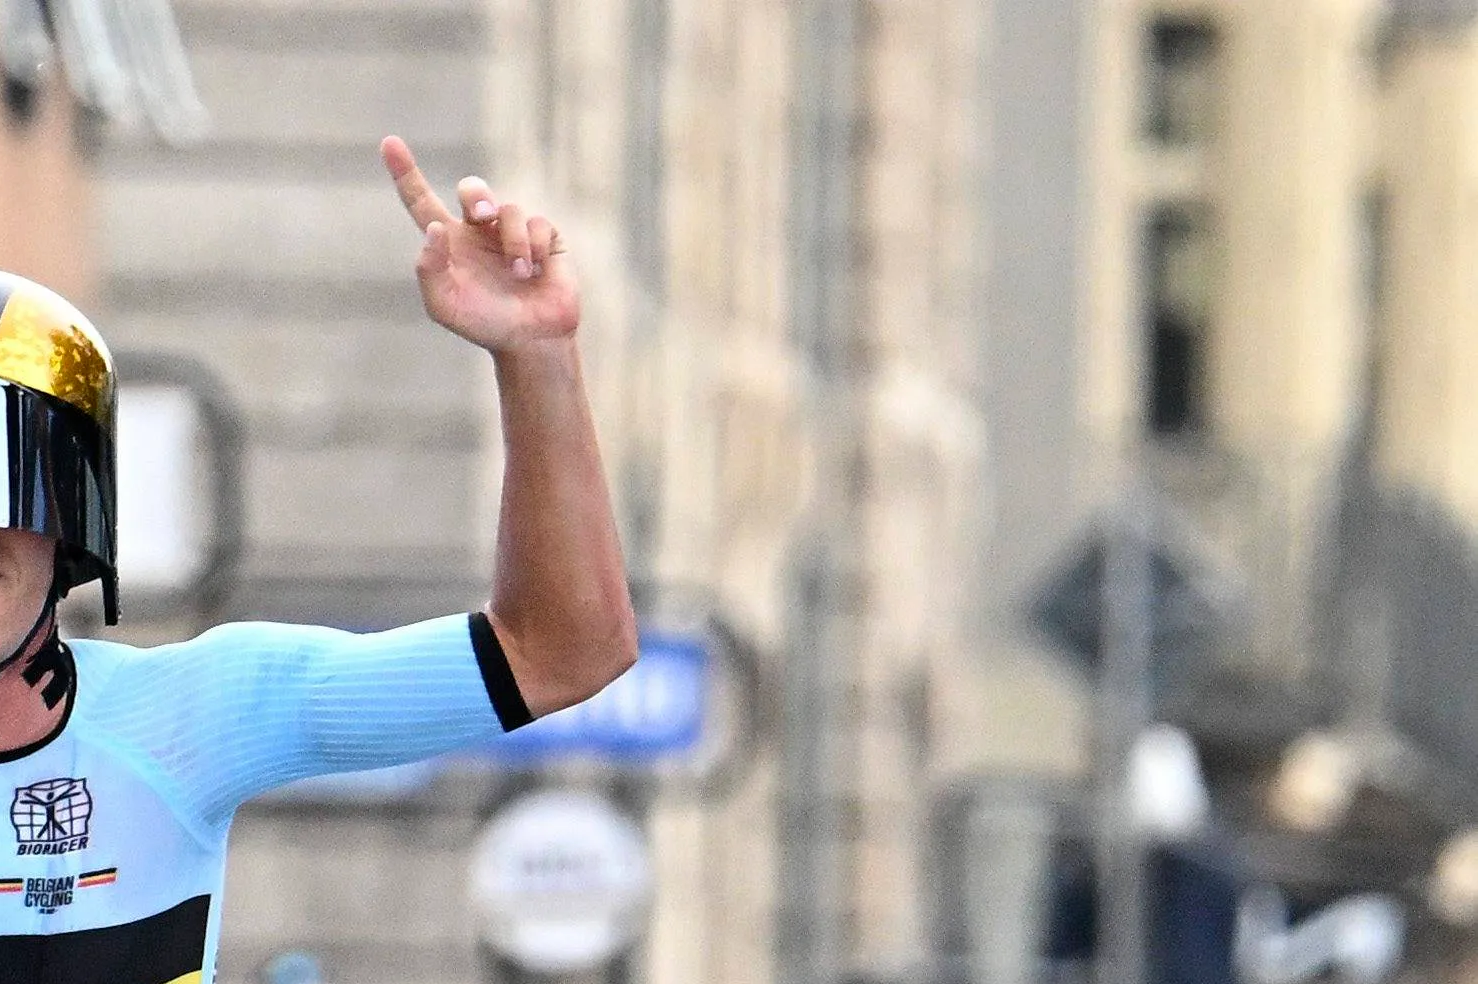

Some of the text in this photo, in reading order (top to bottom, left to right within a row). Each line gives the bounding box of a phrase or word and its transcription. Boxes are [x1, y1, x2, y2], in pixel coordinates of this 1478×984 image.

[16, 836, 89, 856] BIORACER
[26, 875, 74, 892] BELGIAN
[24, 890, 73, 907] CYCLING
